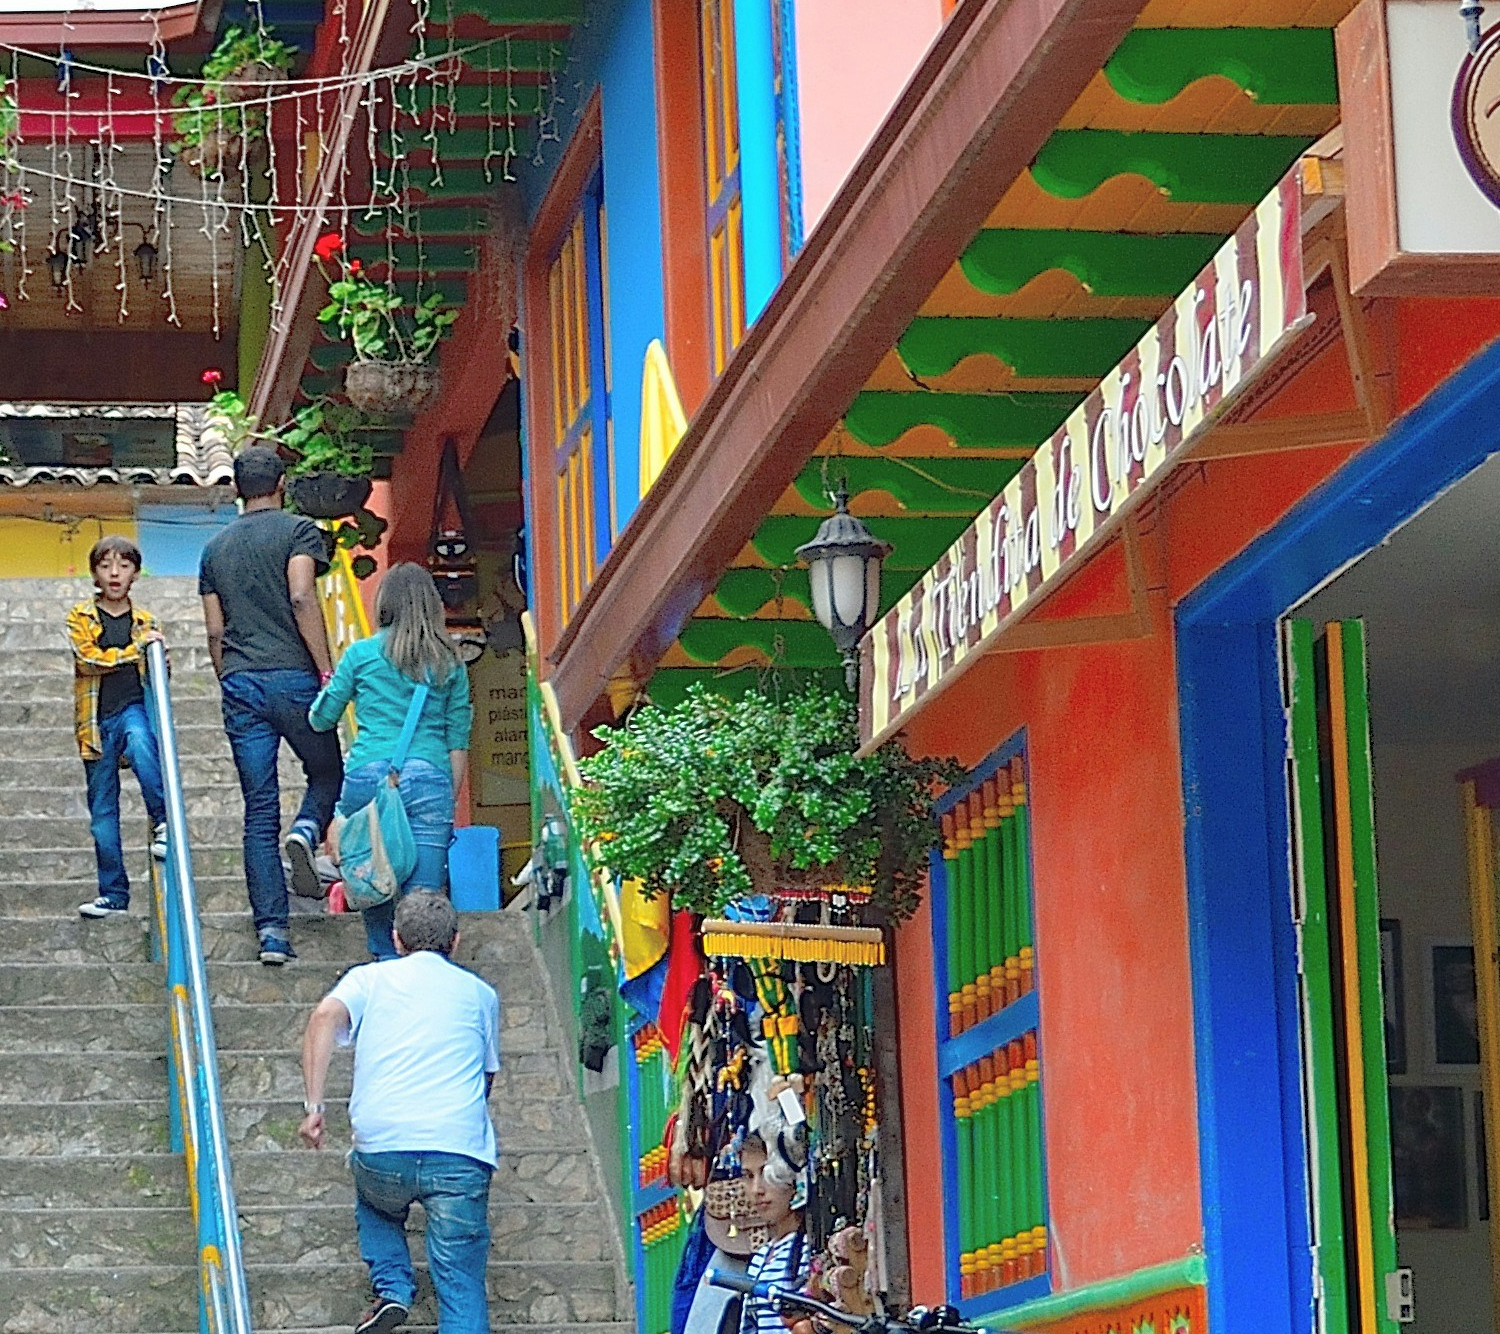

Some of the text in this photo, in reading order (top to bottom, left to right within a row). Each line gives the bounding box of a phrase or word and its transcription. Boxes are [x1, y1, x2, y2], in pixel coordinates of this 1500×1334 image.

[893, 279, 1253, 702] La Tiendita de Chocolate
